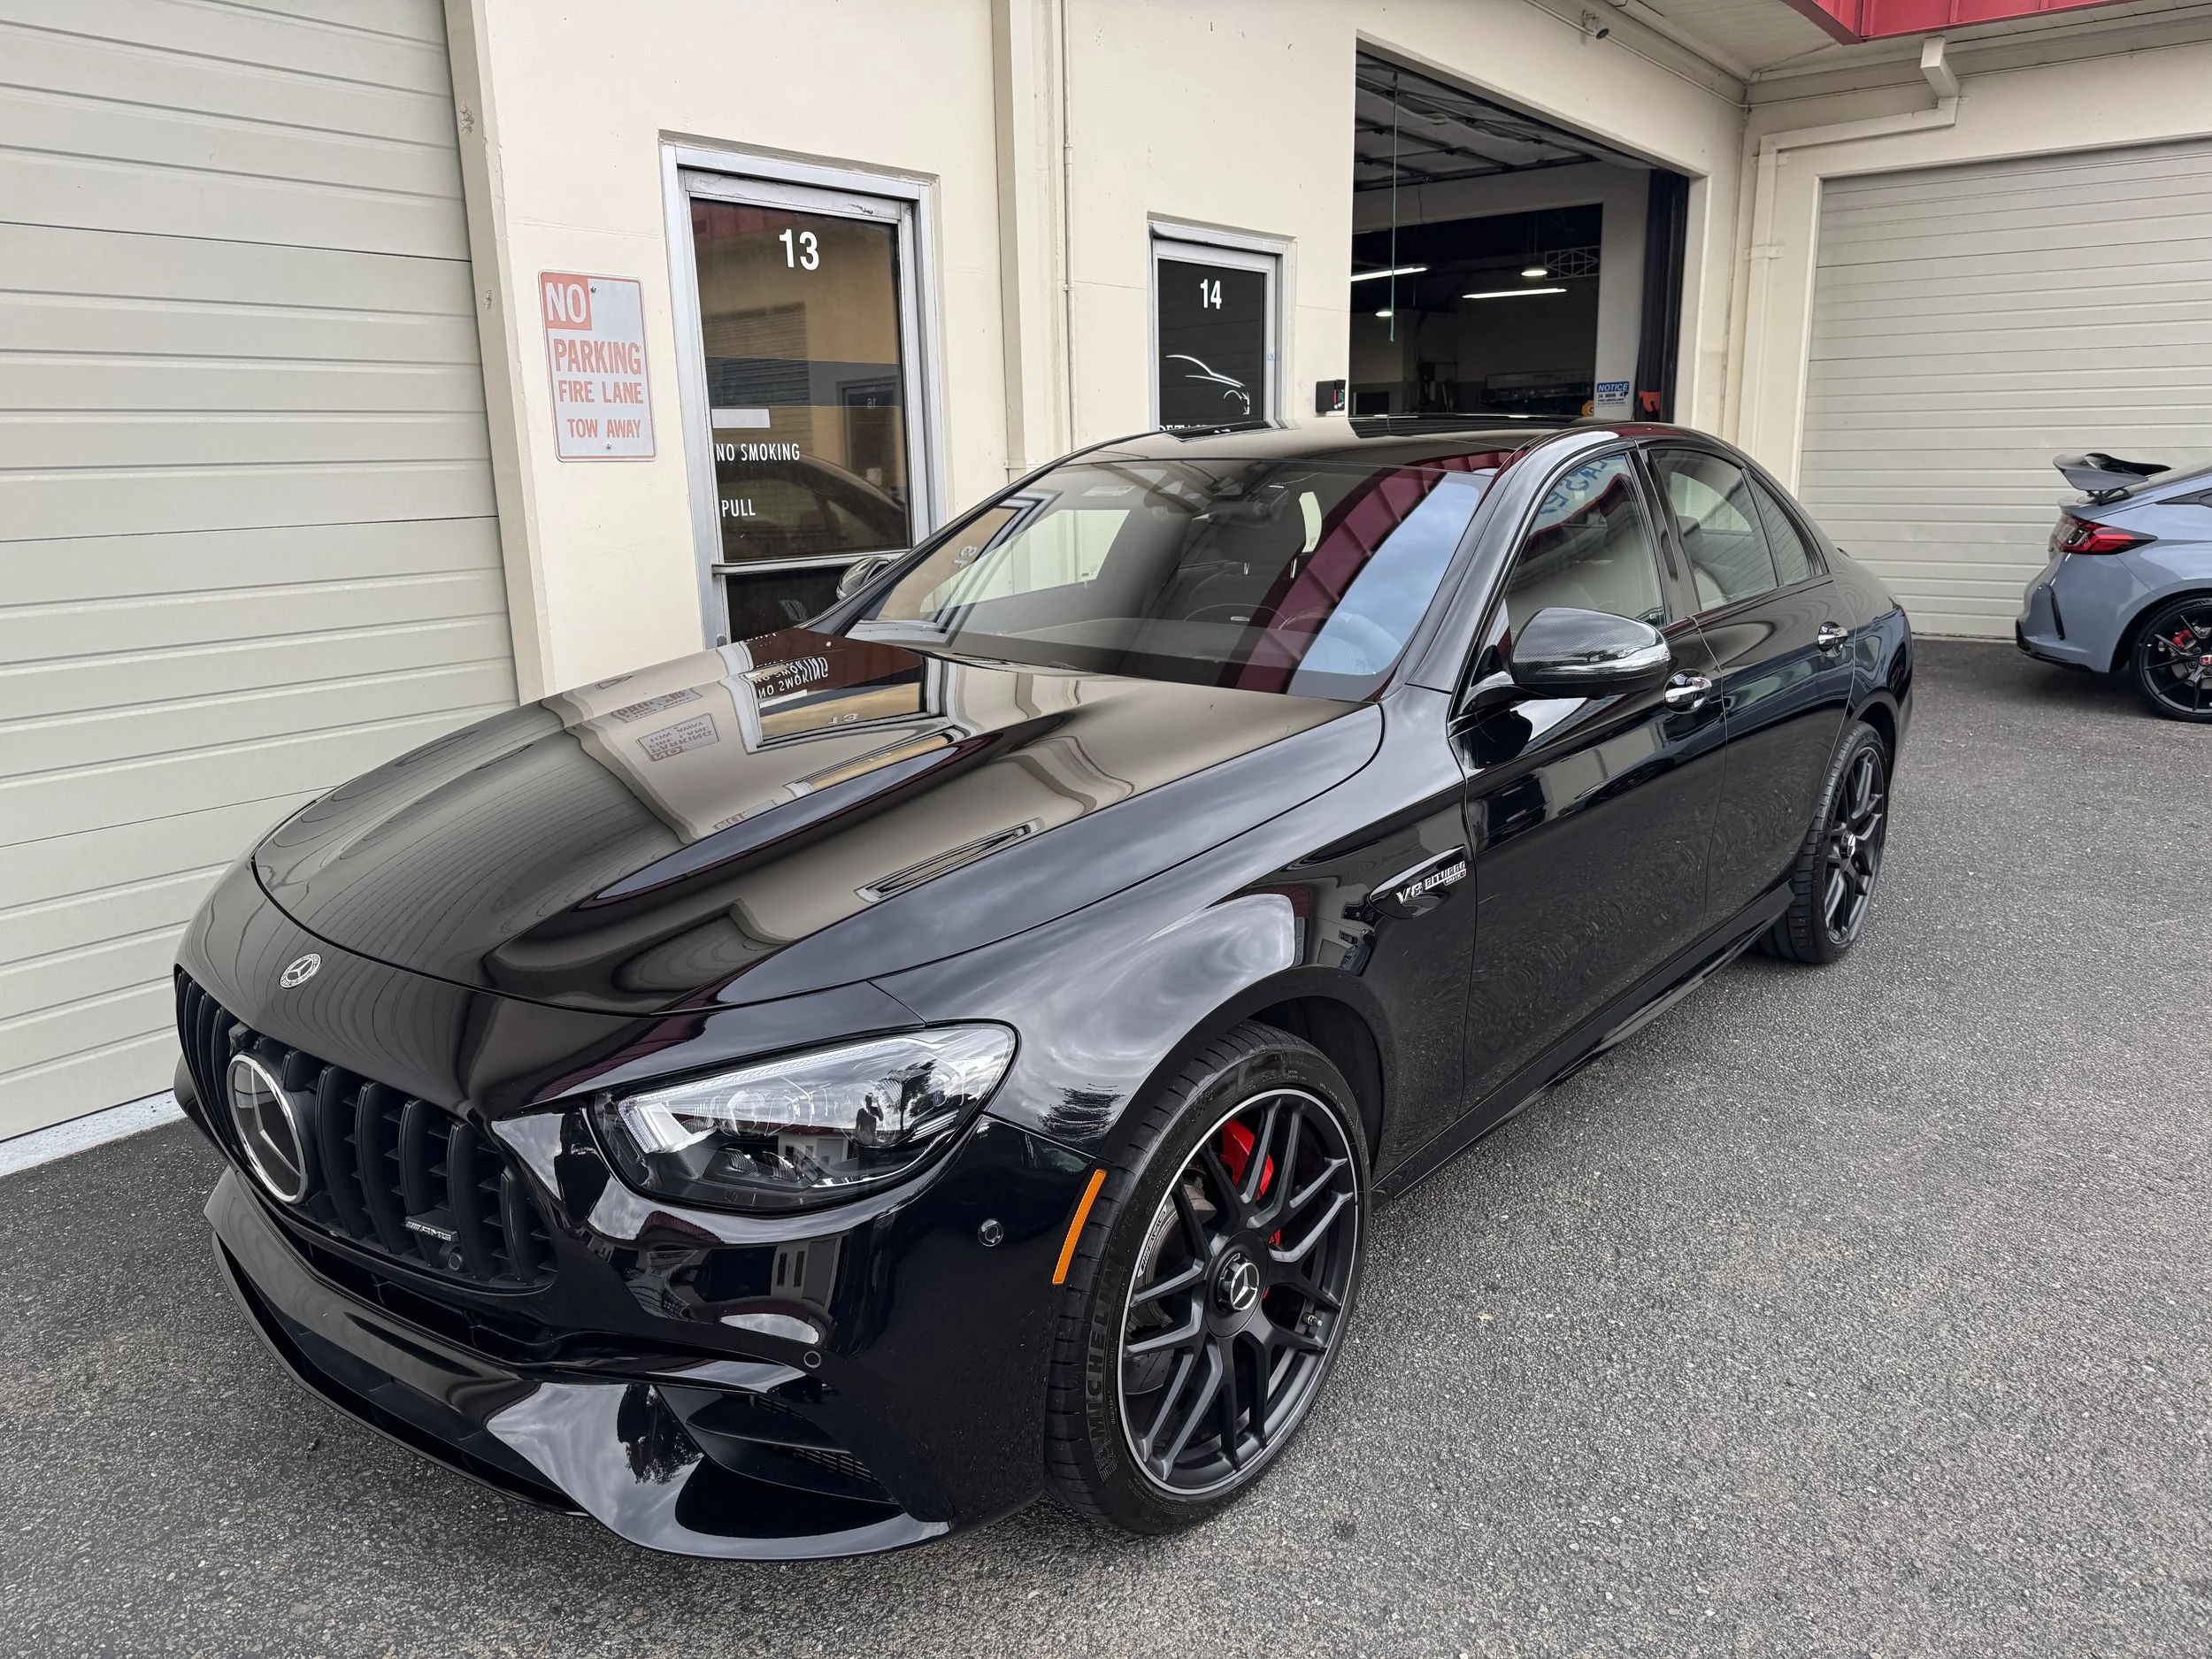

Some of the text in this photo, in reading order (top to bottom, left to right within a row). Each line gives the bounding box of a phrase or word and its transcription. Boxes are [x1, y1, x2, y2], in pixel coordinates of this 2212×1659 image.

[779, 228, 819, 271] 13
[545, 282, 588, 324] NO
[1200, 279, 1222, 310] 14
[553, 338, 642, 375] PARKING
[558, 380, 644, 404] FIRE LANE
[1598, 382, 1629, 392] NOTICE
[567, 419, 641, 439] TOW AWAY
[716, 443, 801, 461] NO SMOKING
[721, 498, 757, 518] PULL
[1395, 881, 1424, 904] V8
[419, 1225, 451, 1242] AMG
